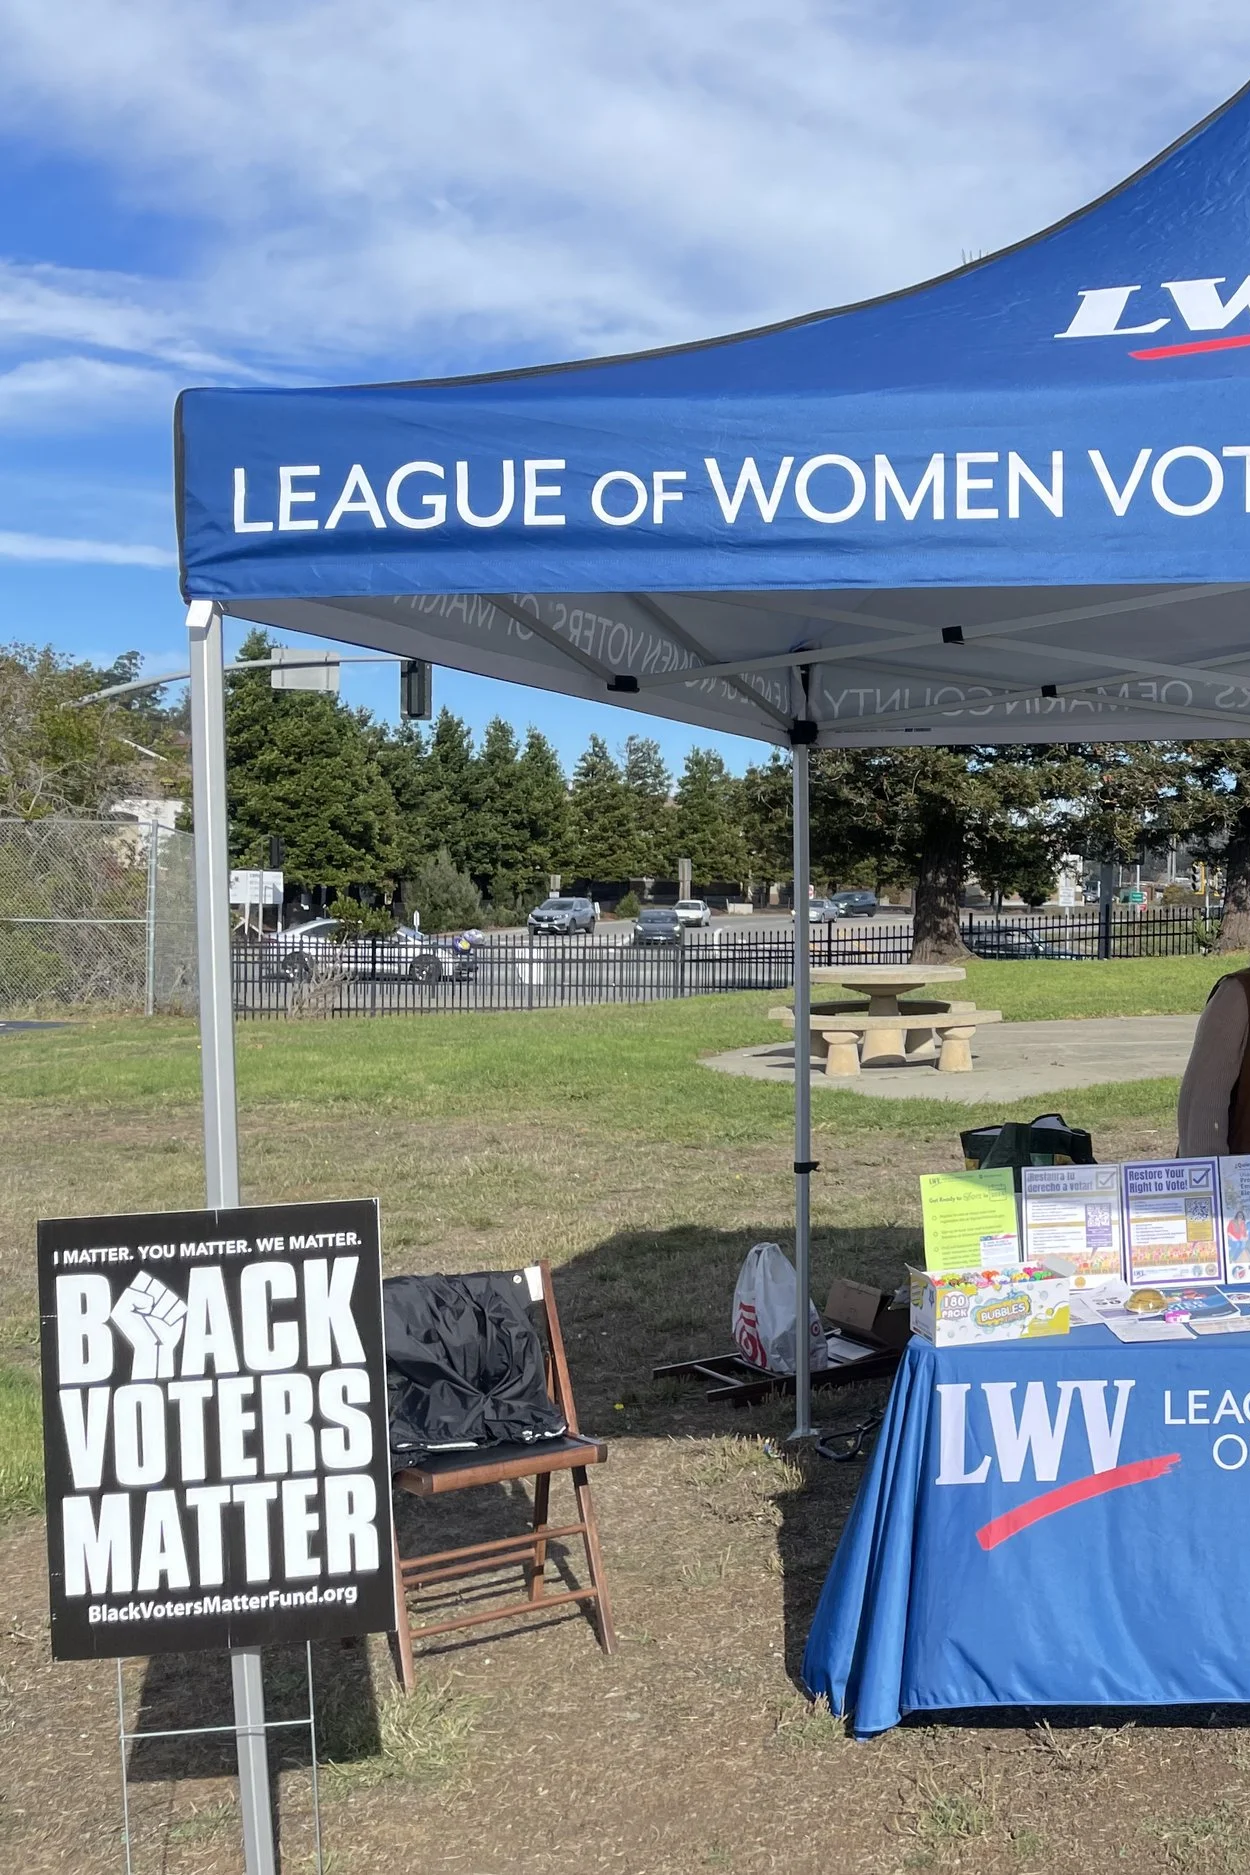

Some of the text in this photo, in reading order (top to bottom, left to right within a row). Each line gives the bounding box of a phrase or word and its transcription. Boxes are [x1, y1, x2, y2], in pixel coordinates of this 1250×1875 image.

[232, 458, 566, 533] LEAGUE
[591, 470, 686, 526] OF
[704, 448, 1064, 525] WOMEN
[1027, 1182, 1061, 1193] derecho
[1069, 1181, 1093, 1192] votar!
[1128, 1168, 1185, 1181] Restore Your
[1129, 1179, 1188, 1194] Right to Vote!
[53, 1232, 362, 1265] I MATTER. YOU MATTER. WE MATTER.
[941, 1308, 968, 1319] PACK
[943, 1294, 965, 1308] 180
[980, 1301, 1026, 1323] BUBBLES
[55, 1256, 367, 1386] BACK
[58, 1368, 374, 1490] VOTERS
[935, 1379, 1136, 1485] LWV
[61, 1473, 380, 1598] MATTER
[88, 1585, 358, 1624] BlackVotersMatterFund.org
